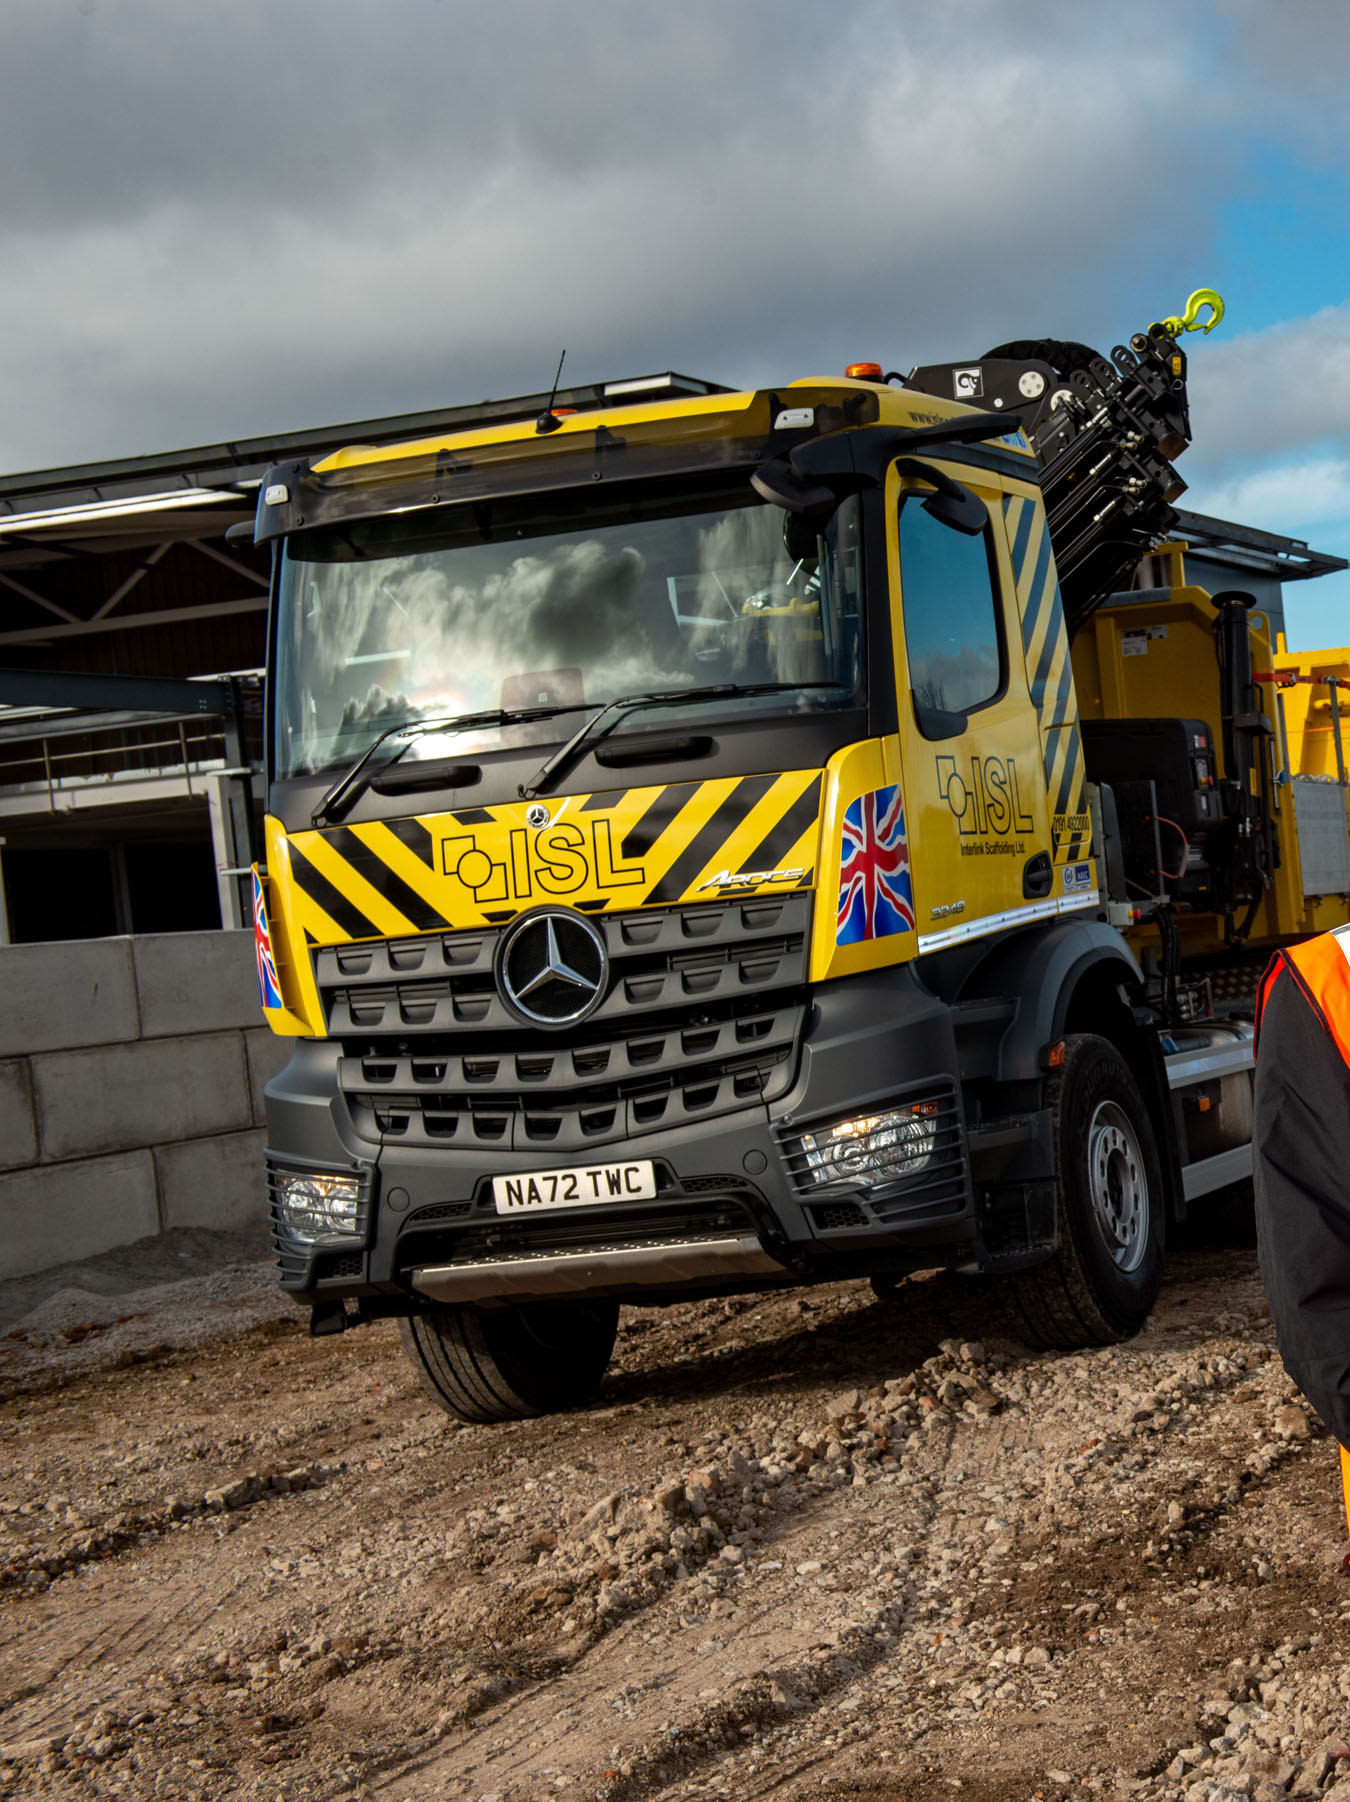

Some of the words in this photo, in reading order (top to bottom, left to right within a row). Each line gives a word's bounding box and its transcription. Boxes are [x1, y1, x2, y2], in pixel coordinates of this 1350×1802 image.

[971, 756, 1034, 836] ISL
[510, 818, 646, 899] ISL
[960, 842, 985, 857] Interlink
[985, 841, 1016, 858] Scaffolding
[505, 1174, 580, 1207] NA72
[586, 1167, 642, 1198] TWC
